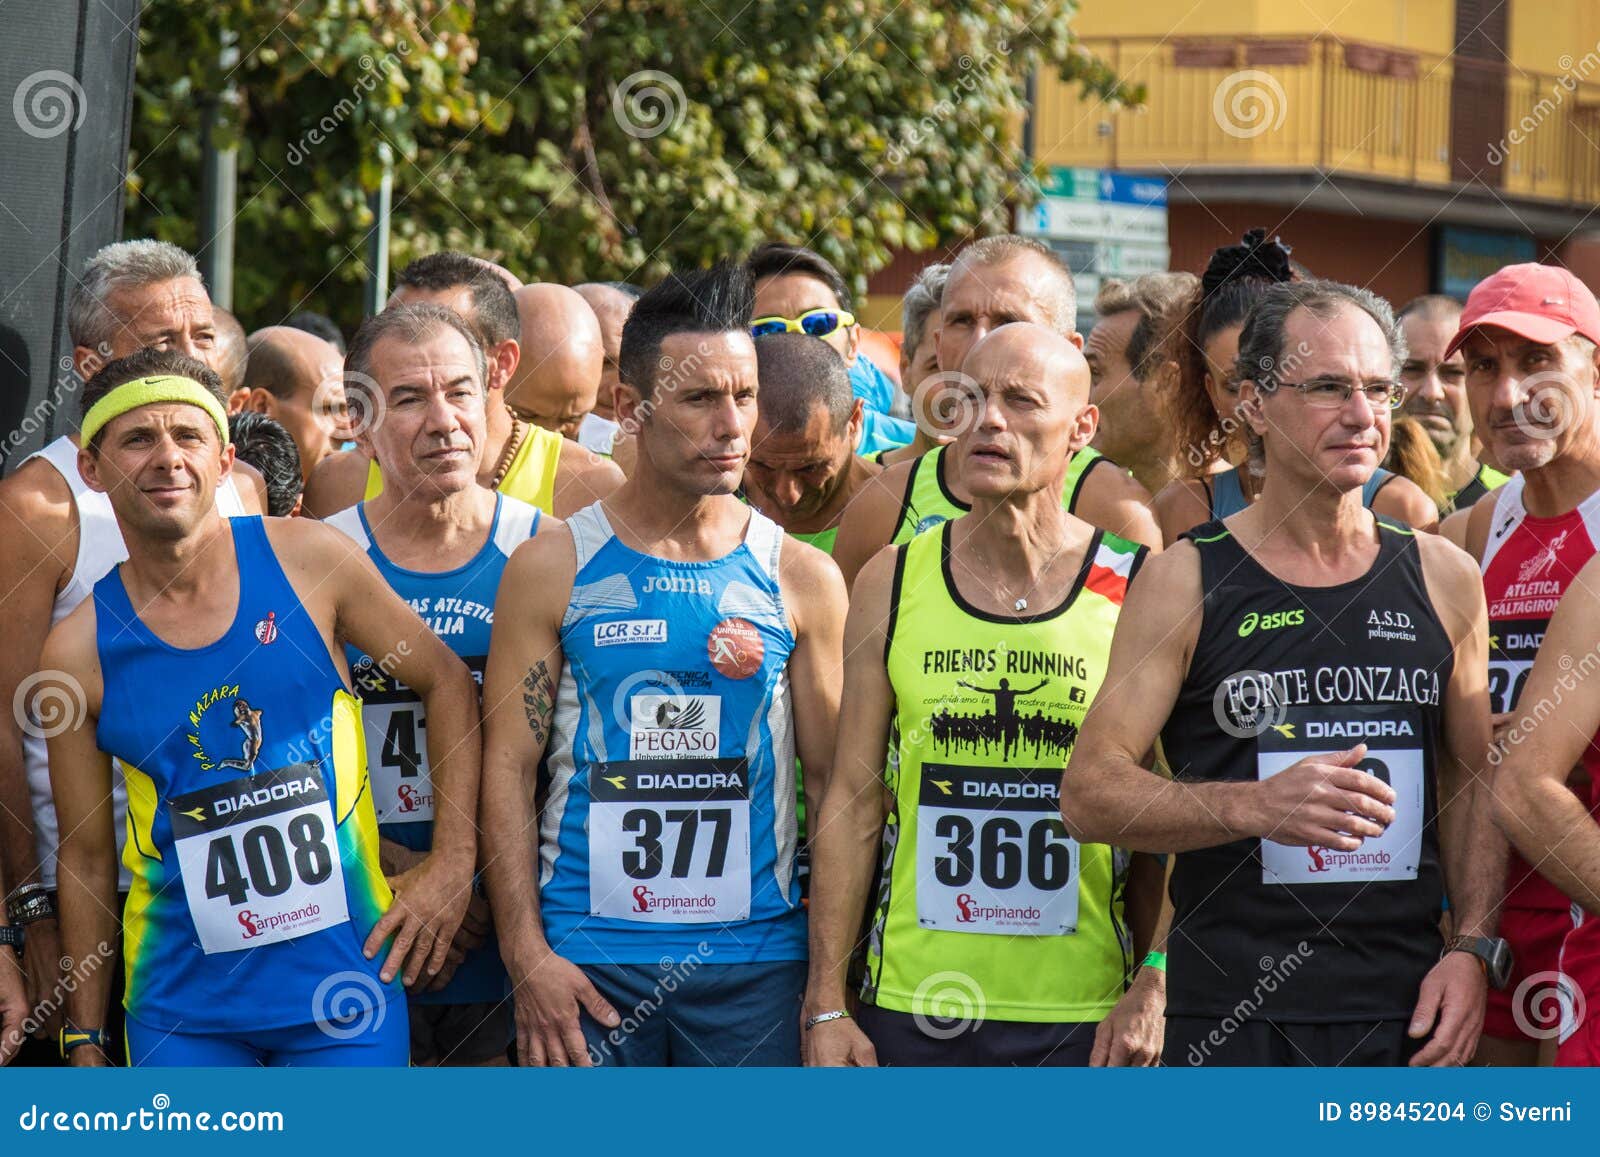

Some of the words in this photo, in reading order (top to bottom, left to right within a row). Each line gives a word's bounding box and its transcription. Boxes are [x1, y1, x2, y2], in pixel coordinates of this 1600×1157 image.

[1505, 580, 1561, 598] ATLETICA
[1367, 609, 1415, 630] A.S.D.
[597, 623, 629, 640] LCR
[1368, 624, 1417, 642] polisportiva
[923, 648, 997, 675] FRIENDS
[1006, 649, 1088, 681] RUNNING
[1223, 668, 1311, 714] FORTE
[1314, 665, 1441, 707] GONZAGA
[188, 683, 242, 728] MAZARA
[1016, 697, 1046, 707] nostra
[1305, 720, 1415, 738] DIADORA
[634, 731, 718, 752] PEGASO
[637, 772, 744, 790] DIADORA
[214, 776, 320, 816] DIADORA
[621, 808, 733, 881] 377
[934, 814, 1072, 892] 366
[204, 812, 334, 908] 408
